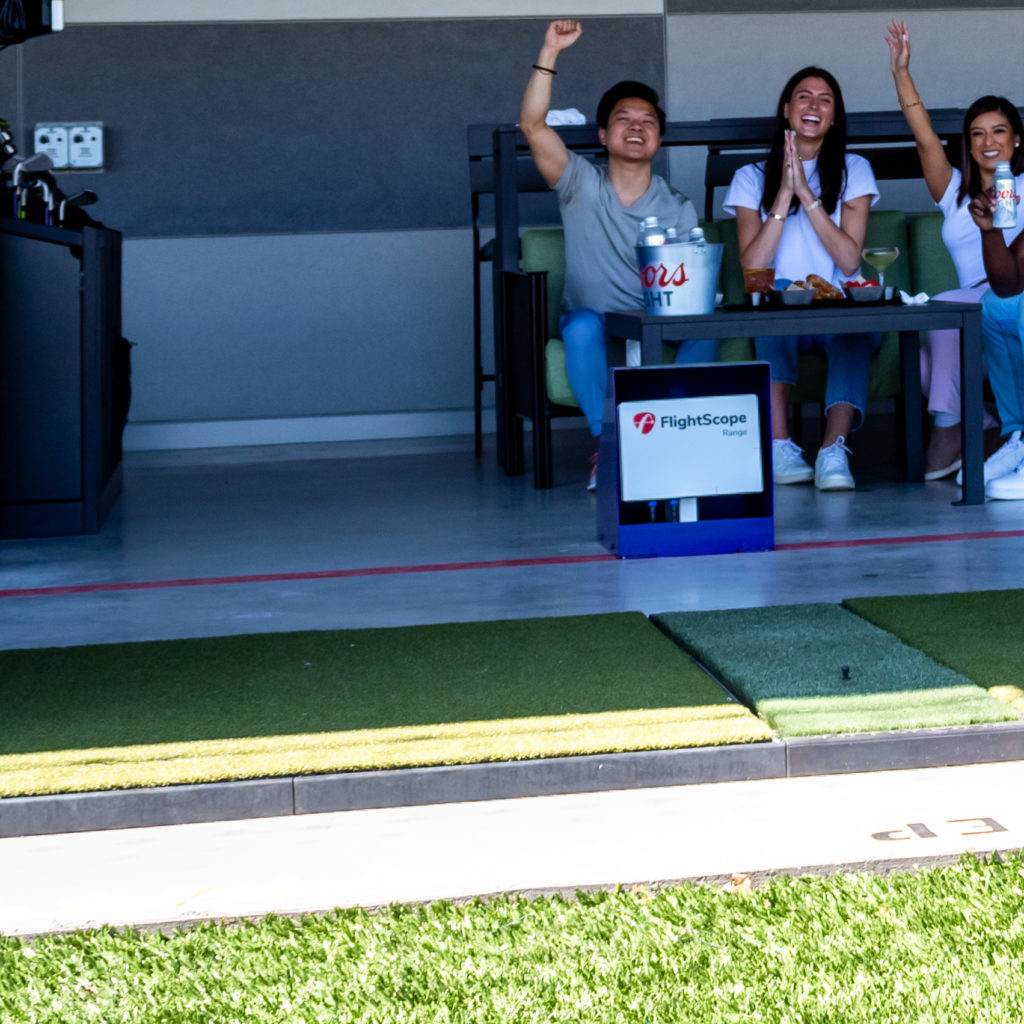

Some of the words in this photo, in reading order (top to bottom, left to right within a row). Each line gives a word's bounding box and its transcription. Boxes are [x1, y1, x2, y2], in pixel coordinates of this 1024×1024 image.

[640, 262, 689, 288] ors
[660, 413, 747, 430] FlightScope
[722, 429, 747, 437] Range
